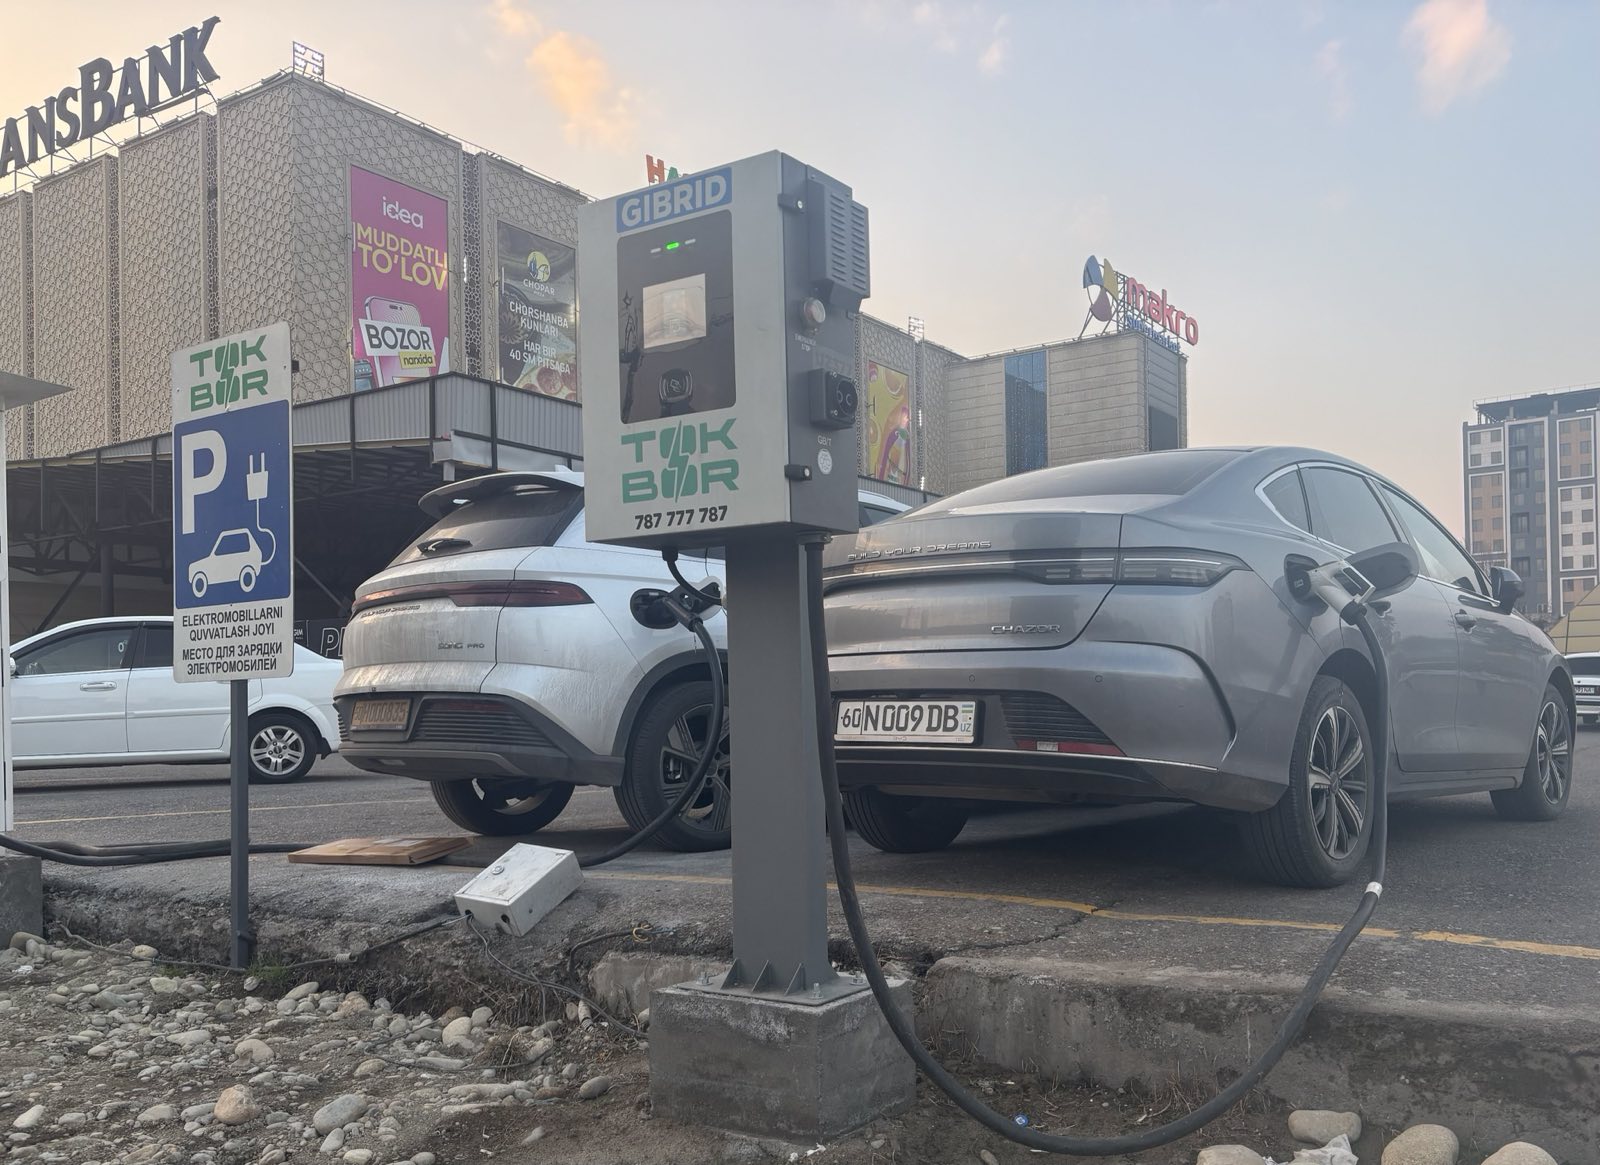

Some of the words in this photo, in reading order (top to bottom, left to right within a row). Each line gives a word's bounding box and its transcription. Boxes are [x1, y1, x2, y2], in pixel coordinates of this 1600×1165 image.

[382, 196, 424, 229] idea
[621, 175, 727, 227] GIBRID
[357, 222, 448, 269] MUDDATLI
[357, 242, 448, 291] TO'LOV
[523, 278, 555, 296] CHOPAR
[509, 301, 569, 329] CHORSHANBA
[1127, 277, 1199, 346] makro
[365, 323, 432, 350] BOZOR
[520, 317, 559, 337] KUNLARI
[403, 354, 433, 366] narxida
[524, 340, 540, 353] HAR
[543, 345, 557, 359] BIR
[509, 349, 521, 361] 40
[537, 357, 571, 375] PITSAGA
[181, 430, 227, 534] P
[635, 512, 662, 530] 787
[666, 508, 694, 527] 777
[698, 505, 728, 523] 787
[884, 546, 922, 557] YOUR
[926, 540, 991, 553] DREAMS
[182, 606, 283, 627] ELEKTROMOBILLARNI
[189, 625, 250, 642] QUVVATLASH
[252, 622, 275, 636] JOYI
[991, 624, 1061, 635] CHAZOR
[182, 646, 214, 661] МЕСТО
[215, 645, 235, 660] ДЛЯ
[237, 642, 282, 657] ЗАРЯДКИ
[320, 627, 346, 657] P
[187, 656, 277, 675] ЭЛЕКТРОМОБИЛЕЙ
[842, 708, 861, 728] 60
[961, 723, 972, 732] UZ
